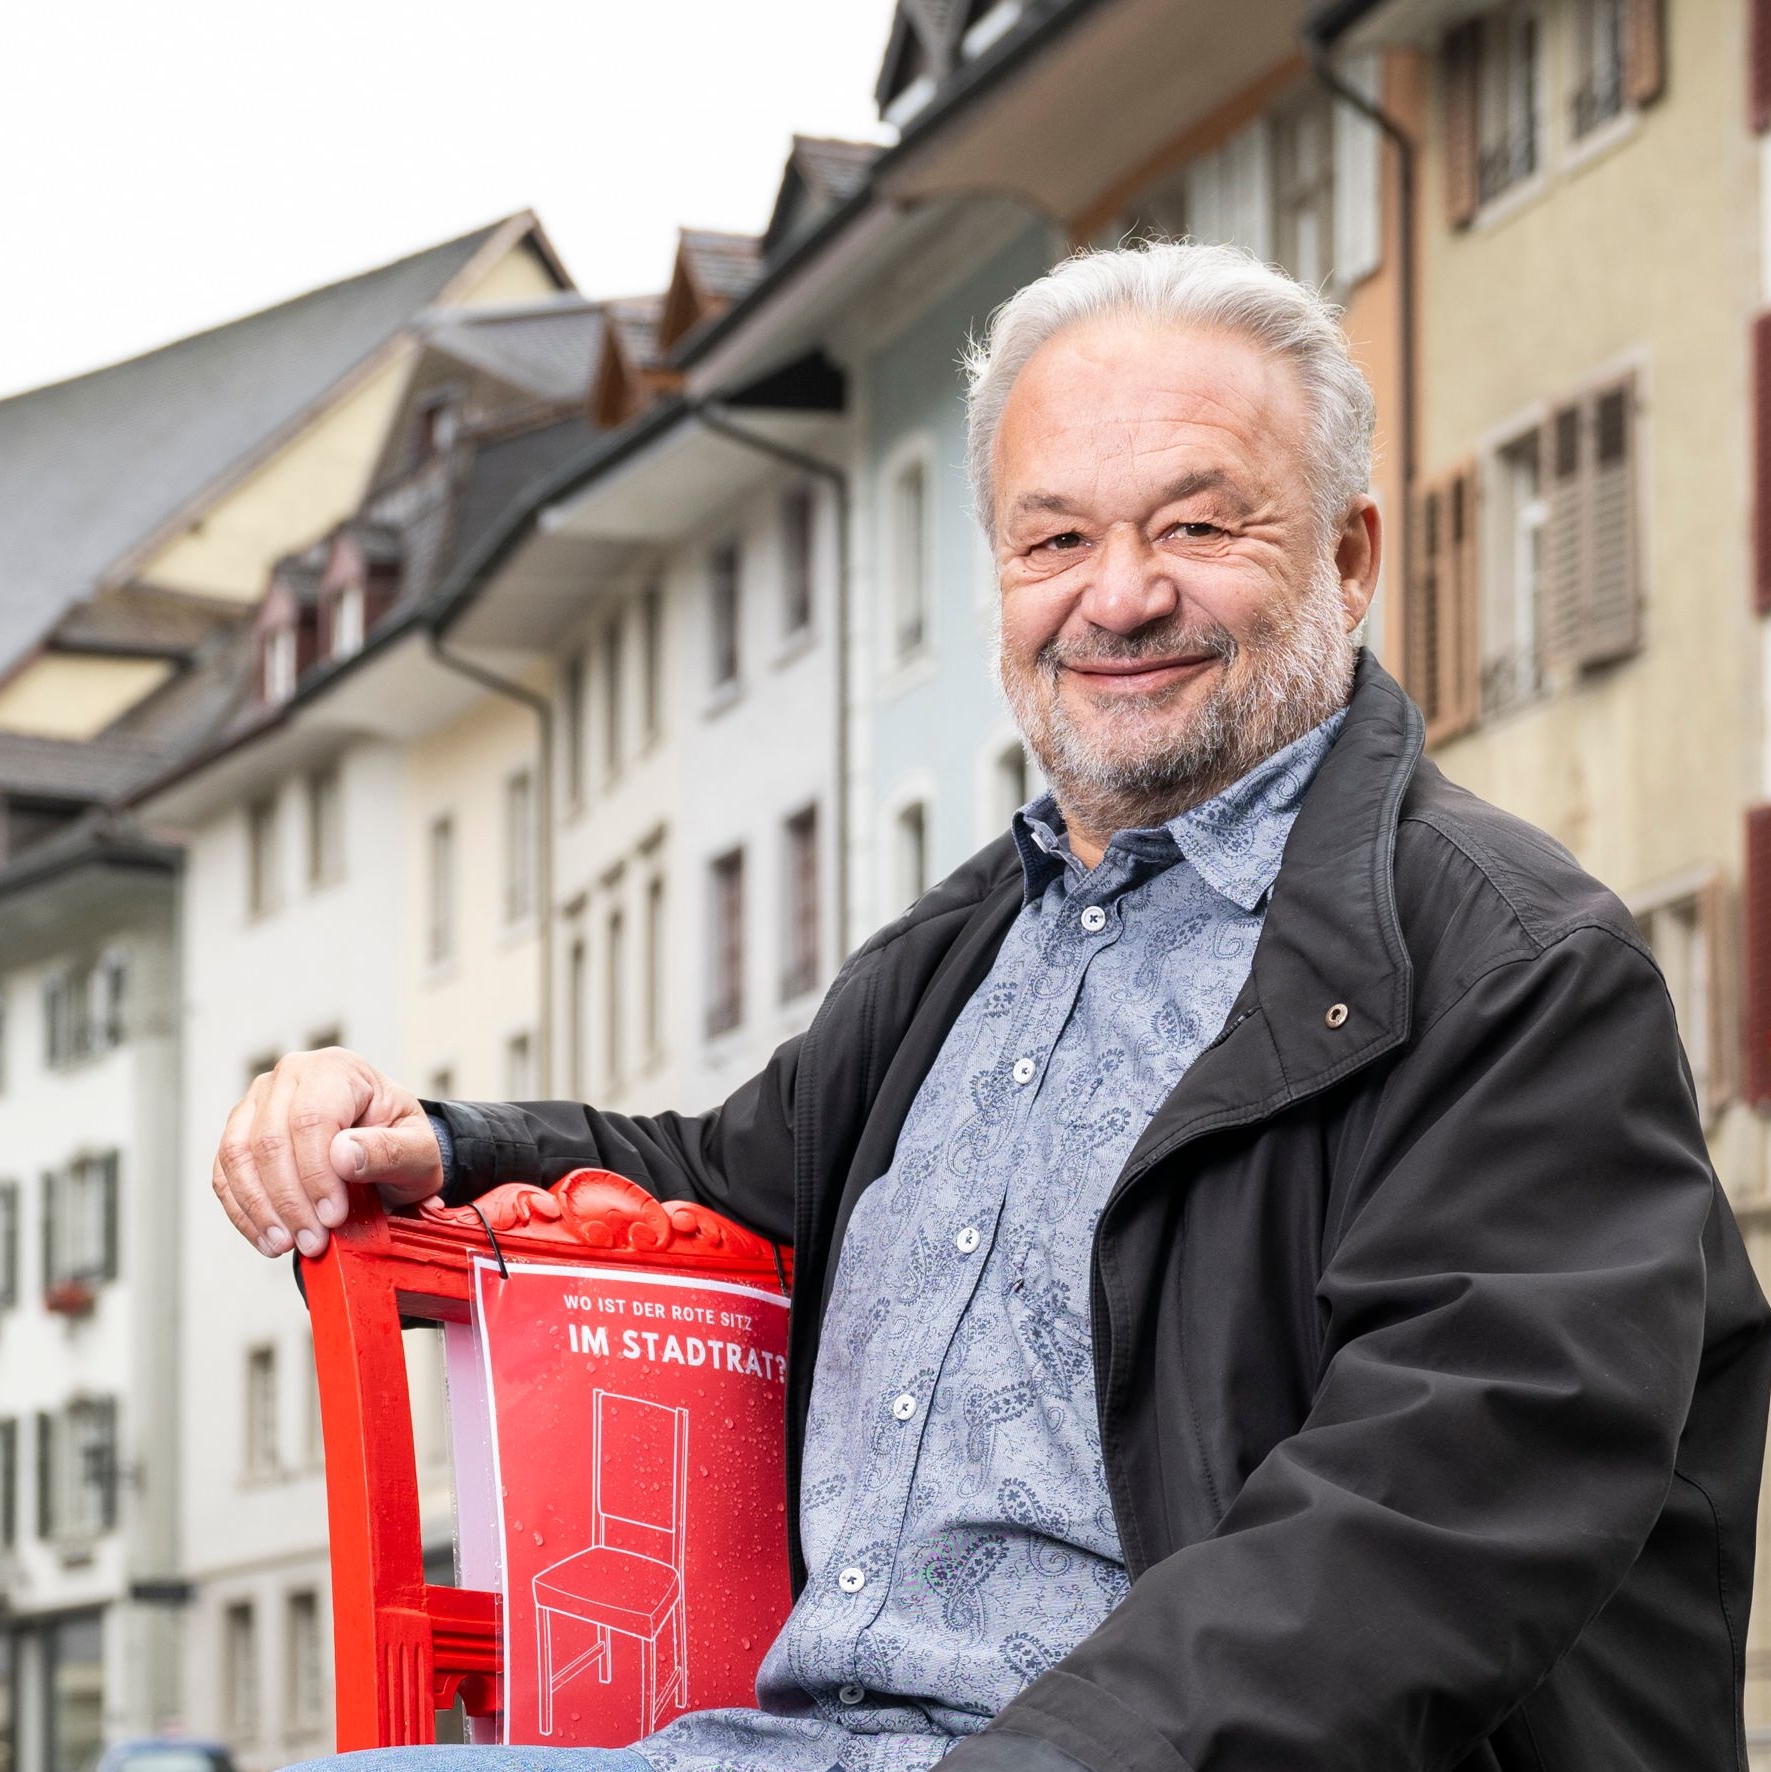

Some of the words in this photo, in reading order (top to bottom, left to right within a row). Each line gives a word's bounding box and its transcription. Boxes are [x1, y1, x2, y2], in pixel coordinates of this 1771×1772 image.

[563, 1294, 592, 1311] WO
[598, 1298, 627, 1314] IST
[632, 1301, 666, 1319] DER
[671, 1305, 715, 1325] ROTE
[720, 1312, 753, 1331] SITZ
[568, 1324, 610, 1356] IM
[622, 1329, 787, 1384] STADTRAT?
